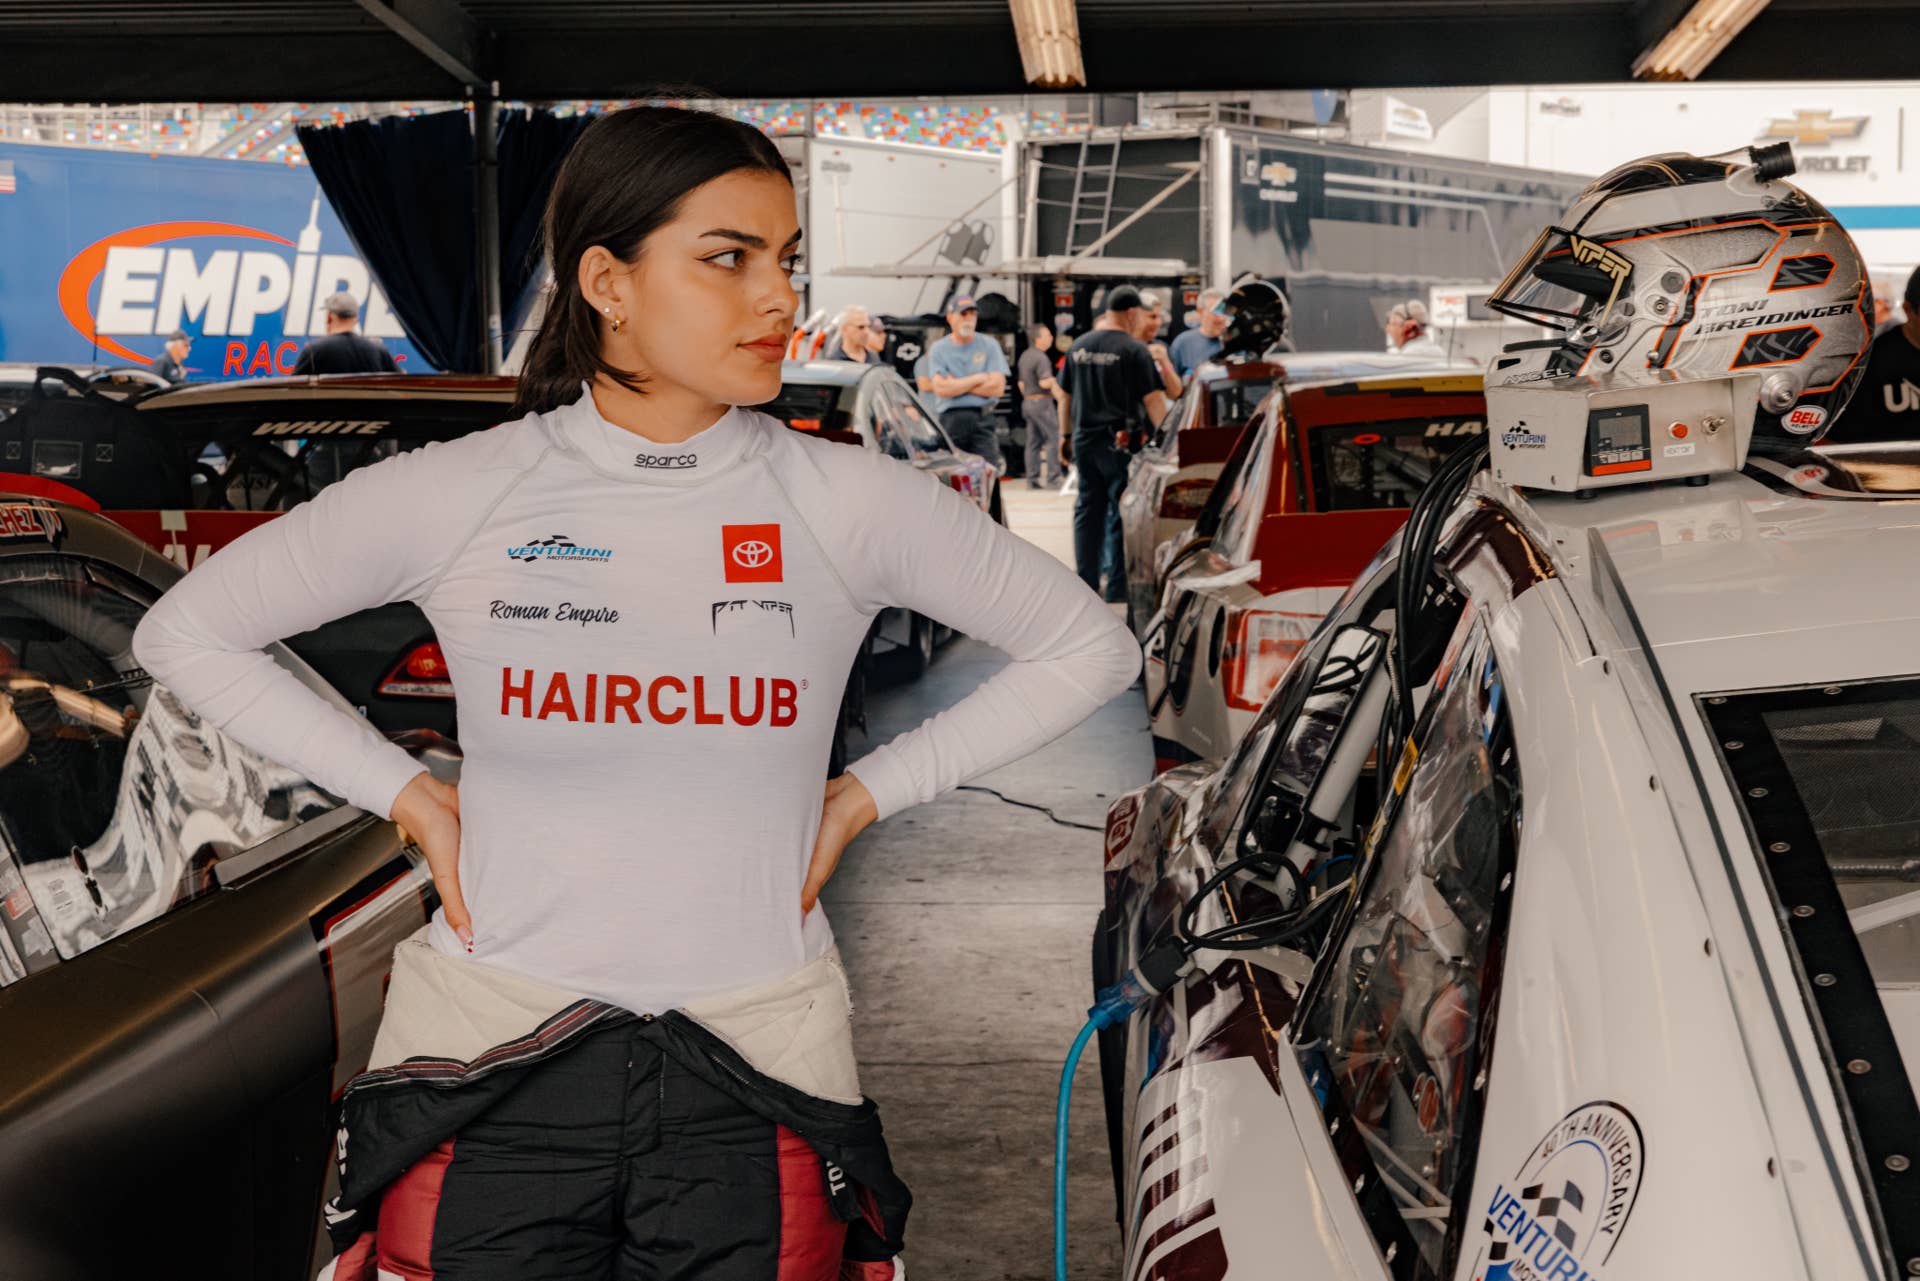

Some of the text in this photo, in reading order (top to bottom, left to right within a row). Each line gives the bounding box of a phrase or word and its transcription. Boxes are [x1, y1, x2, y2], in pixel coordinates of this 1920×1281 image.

[1570, 234, 1634, 327] VIPER
[1700, 299, 1769, 318] TONI
[1694, 303, 1854, 335] BREIDINGER
[1790, 410, 1822, 426] BELL
[252, 420, 391, 436] WHITE
[1501, 433, 1547, 445] VENTURINI
[634, 453, 697, 469] sparco
[507, 546, 612, 557] VENTURINI
[546, 555, 609, 563] MOTORSPORTS
[489, 599, 620, 628] Roman Empire
[501, 667, 798, 727] HAIRCLUB
[1579, 1113, 1632, 1235] ANNIVERSARY
[1487, 1185, 1595, 1281] VENTUR
